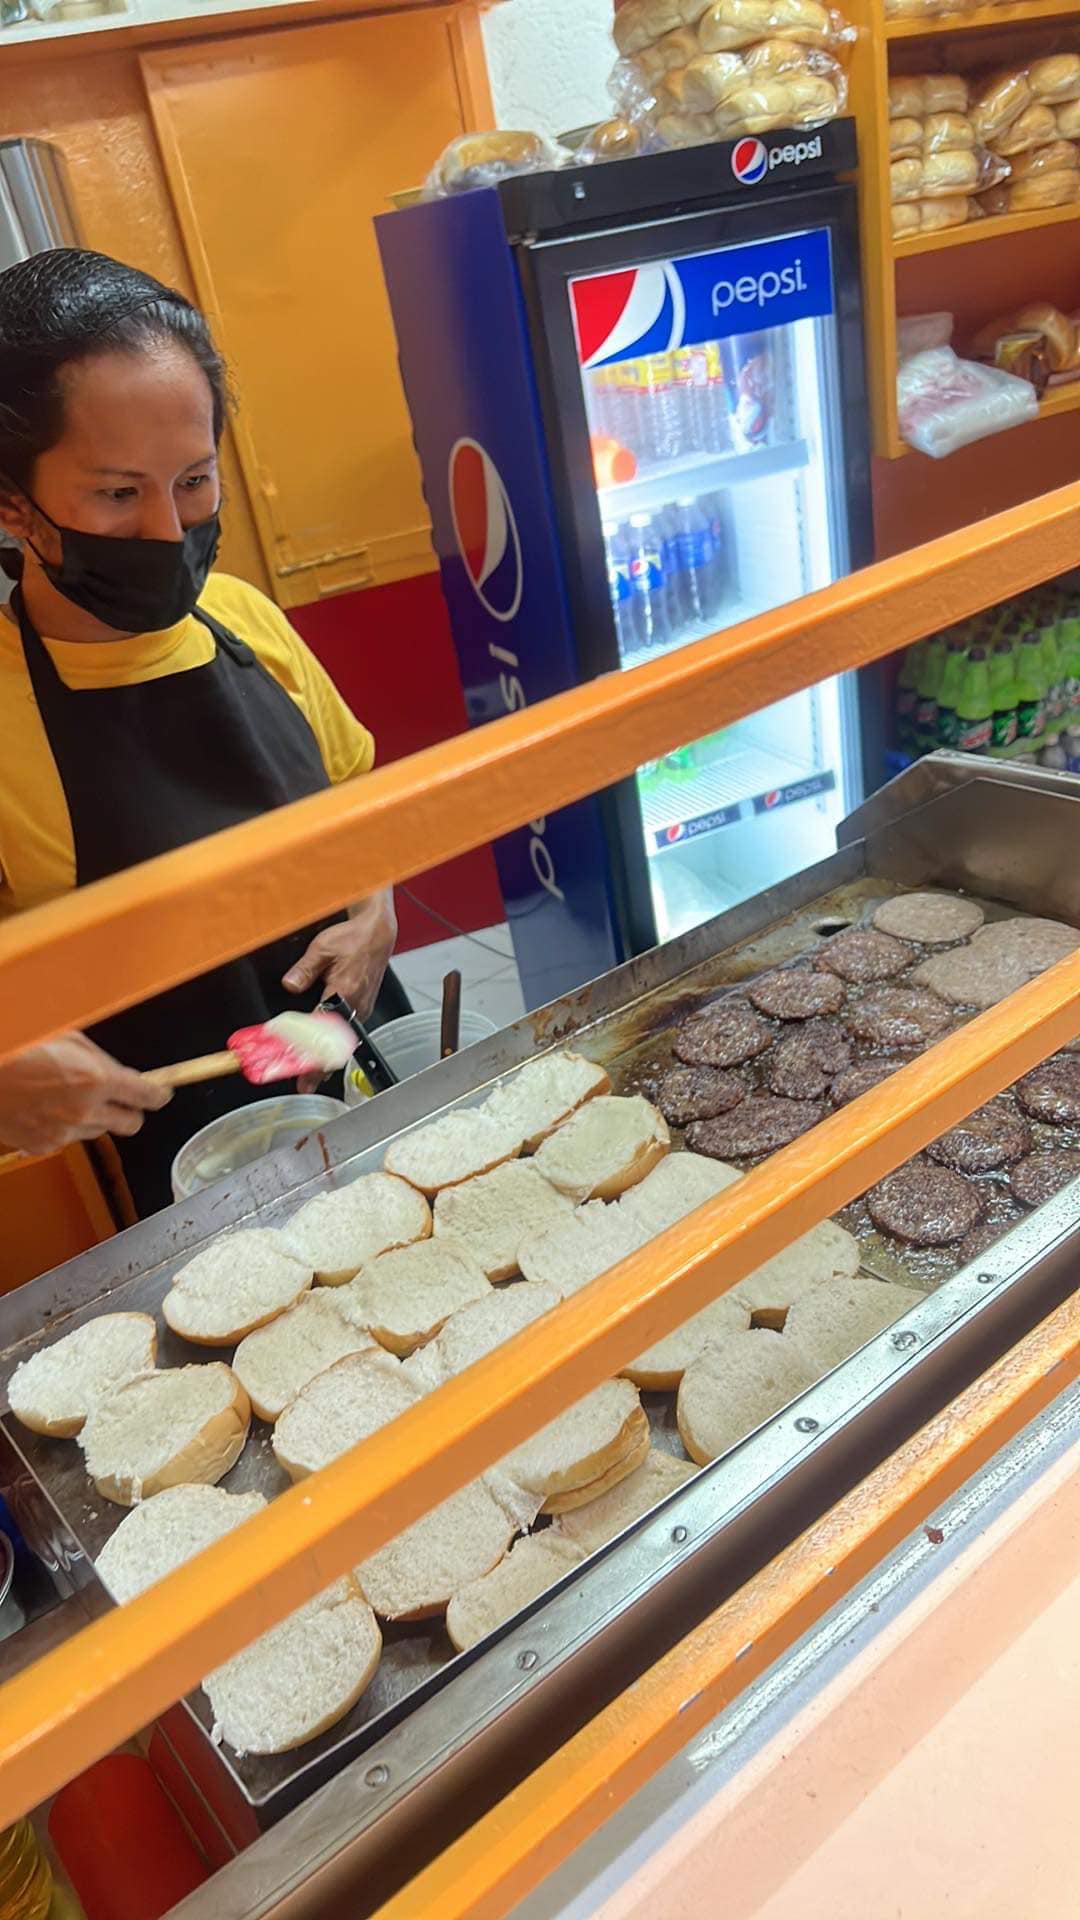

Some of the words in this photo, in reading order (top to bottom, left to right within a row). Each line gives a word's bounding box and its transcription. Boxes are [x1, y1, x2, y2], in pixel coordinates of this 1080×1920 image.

[768, 136, 822, 170] pepsi
[711, 259, 802, 317] pepsi
[687, 811, 726, 835] pepsi
